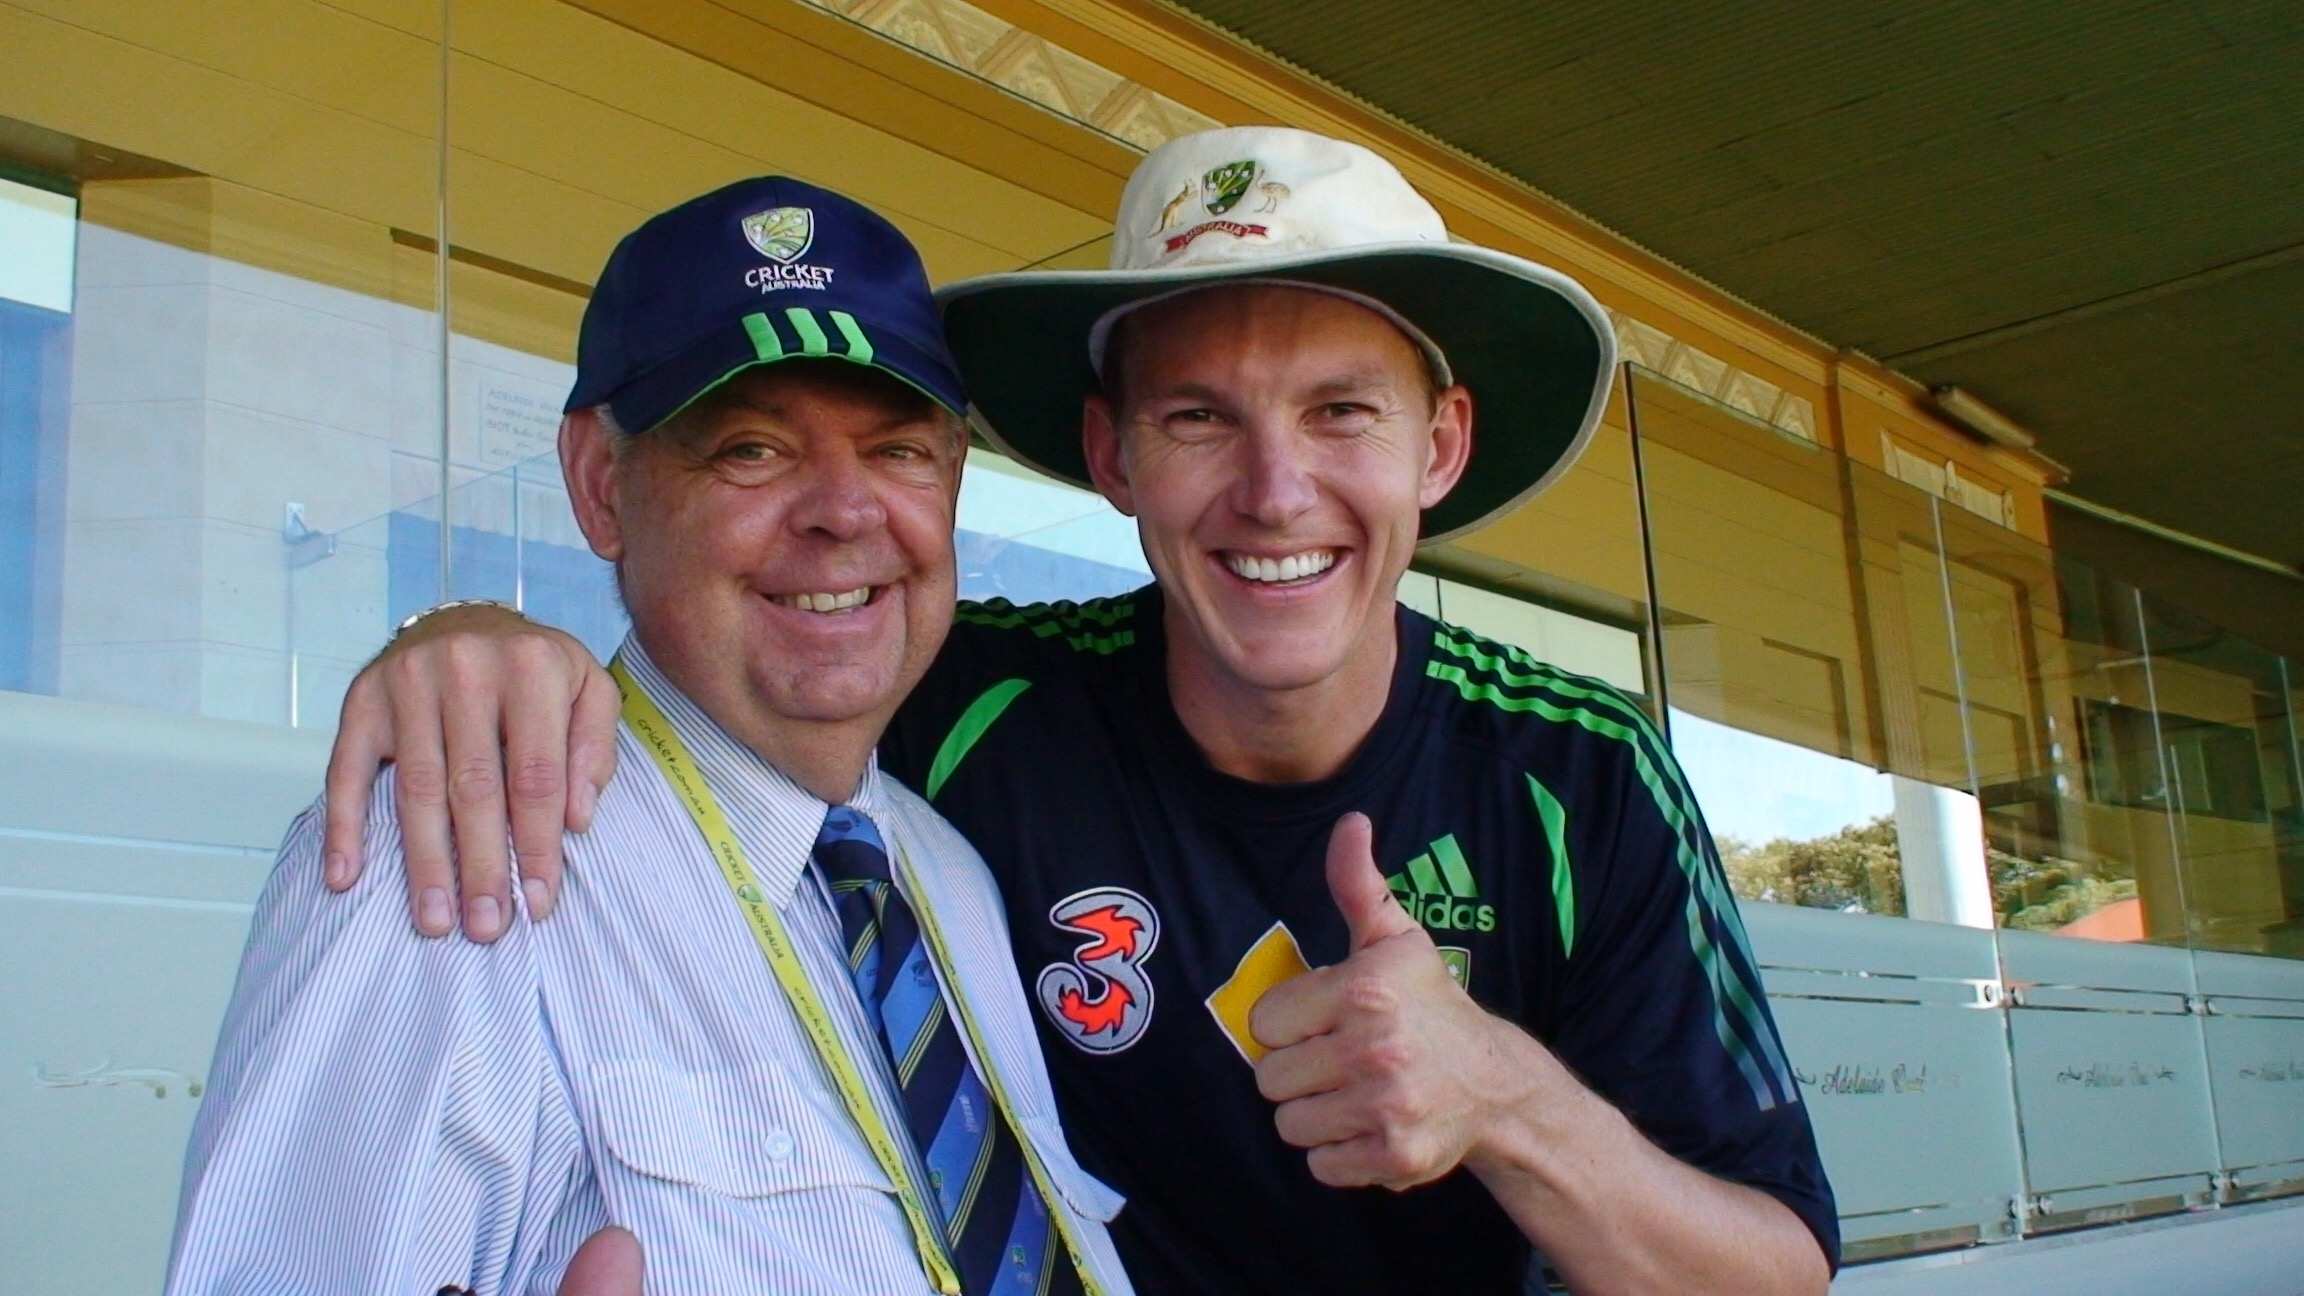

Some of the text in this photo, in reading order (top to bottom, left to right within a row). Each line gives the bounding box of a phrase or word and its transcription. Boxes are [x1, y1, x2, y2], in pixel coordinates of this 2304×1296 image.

[744, 263, 835, 288] CRICKET
[761, 279, 827, 295] AUSTRALIA
[1399, 890, 1496, 932] didas
[1036, 886, 1161, 1055] 3
